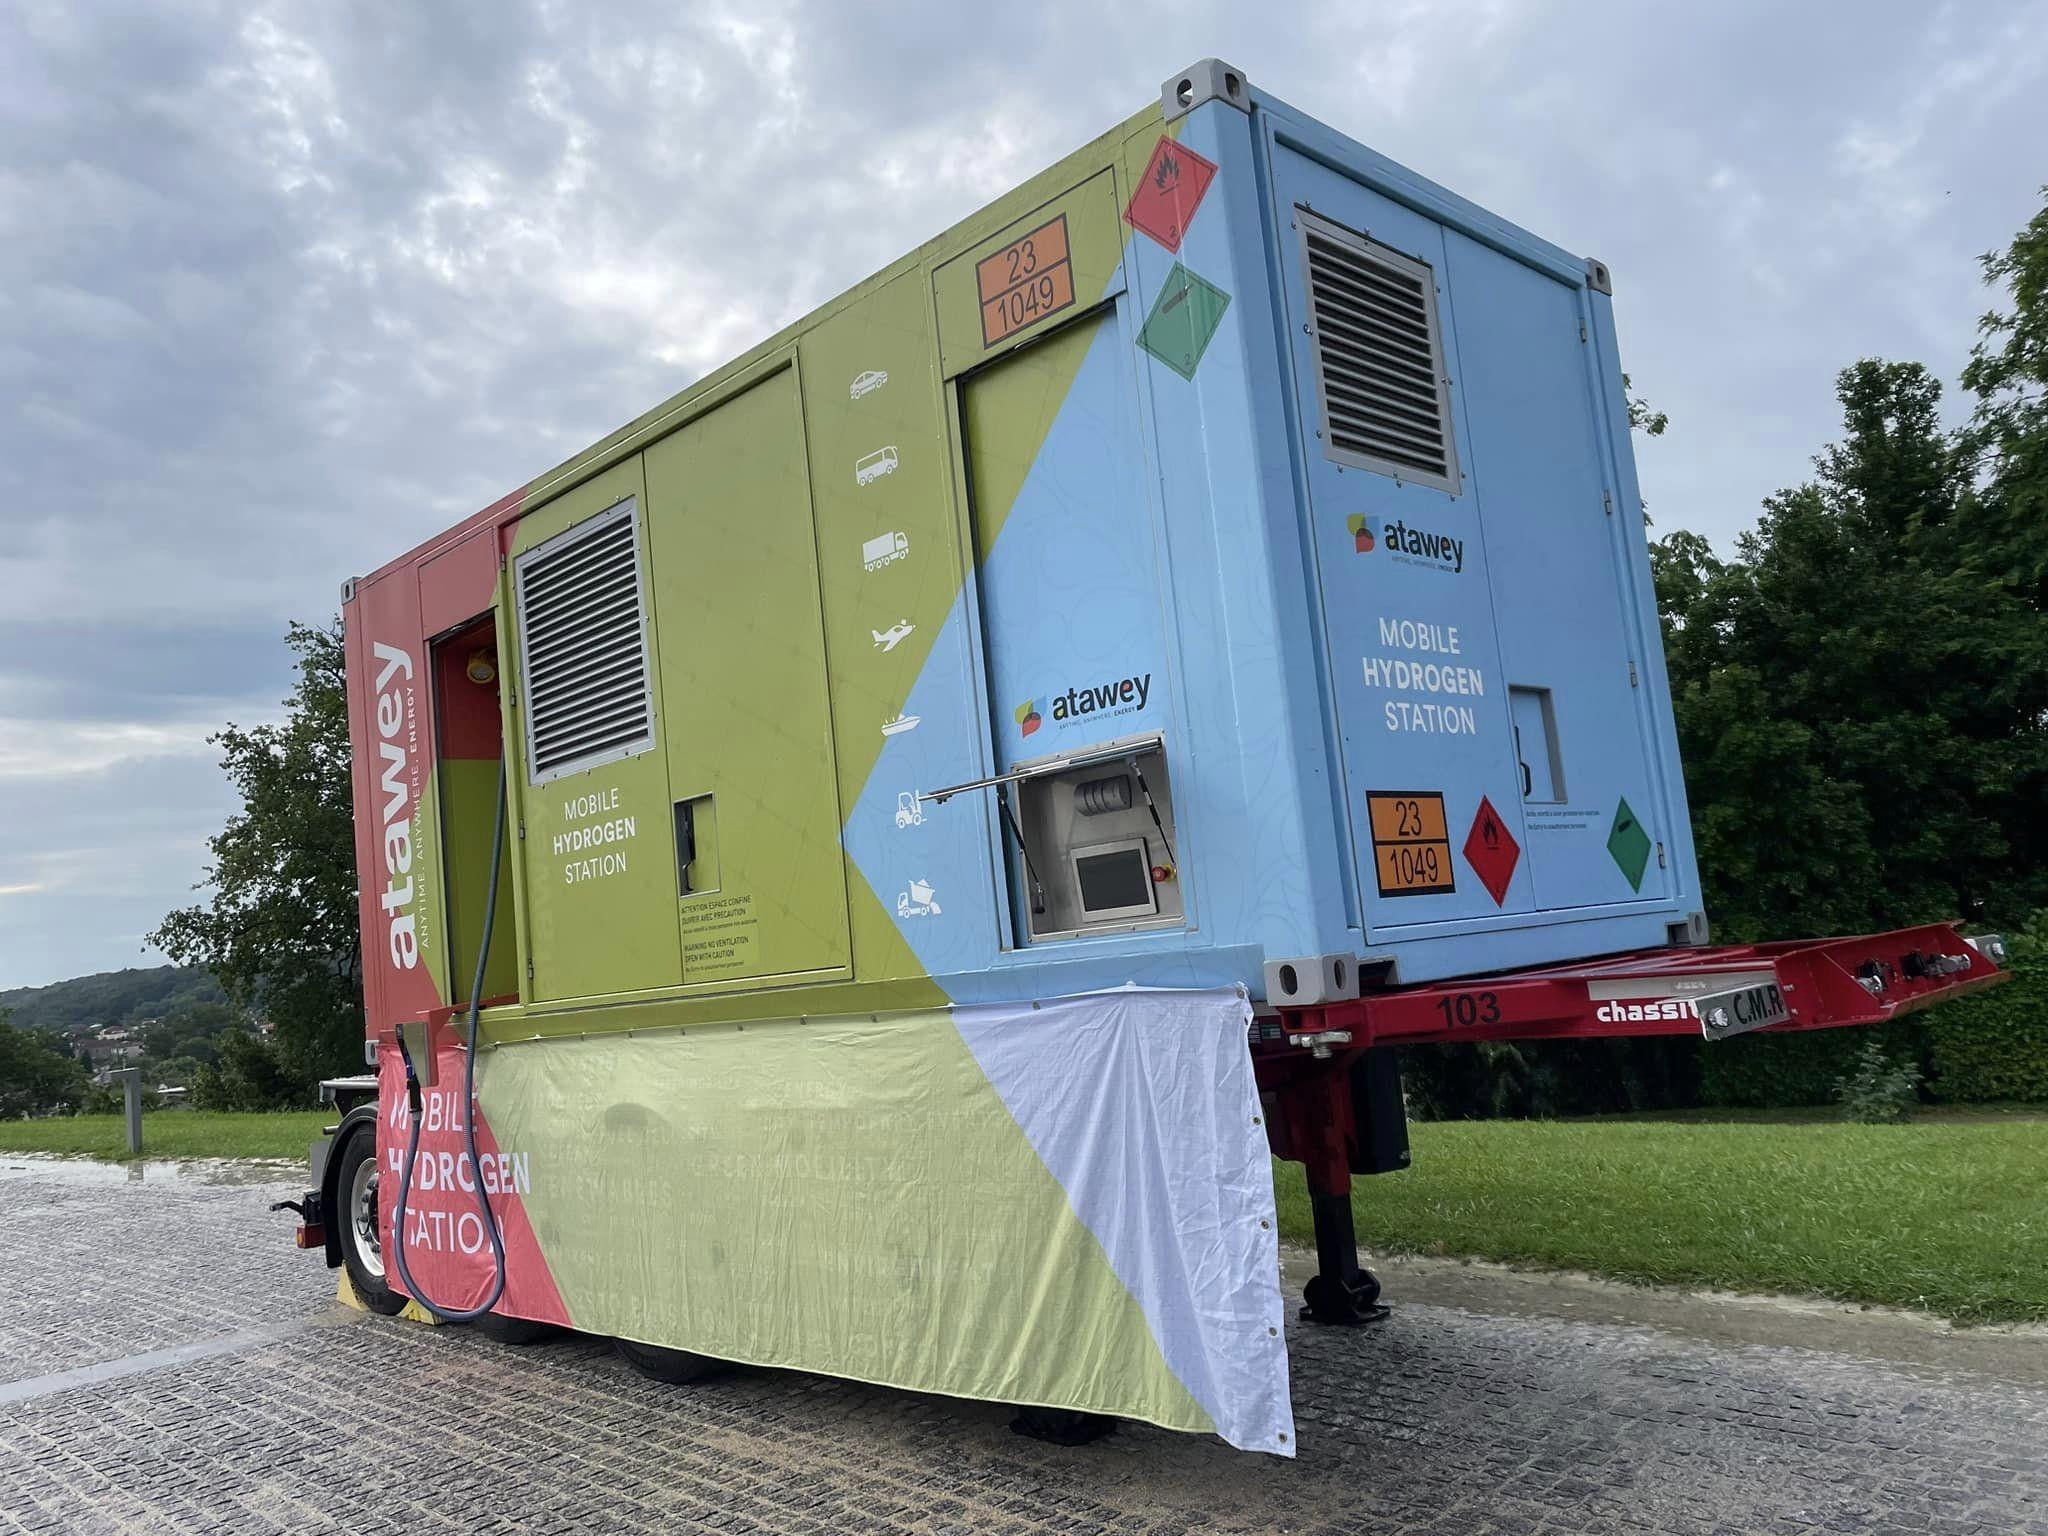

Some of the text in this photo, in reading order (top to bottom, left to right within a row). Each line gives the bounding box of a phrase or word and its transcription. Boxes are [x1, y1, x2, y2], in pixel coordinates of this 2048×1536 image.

[1007, 239, 1037, 284] 23
[998, 275, 1054, 332] 1049
[1384, 519, 1463, 573] atawey
[1378, 616, 1461, 656] MOBILE
[1052, 673, 1151, 721] atawey
[1362, 656, 1484, 697] HYDROGEN
[407, 687, 417, 753] ENERGY
[1384, 701, 1477, 736] STATION
[373, 640, 419, 970] atawey
[564, 787, 619, 821] MOBILE
[1394, 800, 1423, 838] 23
[553, 815, 637, 856] HYDROGEN
[565, 851, 627, 884] STATION
[1390, 851, 1439, 885] 1049
[1436, 991, 1502, 1030] 103
[391, 1205, 505, 1255] TATIO
